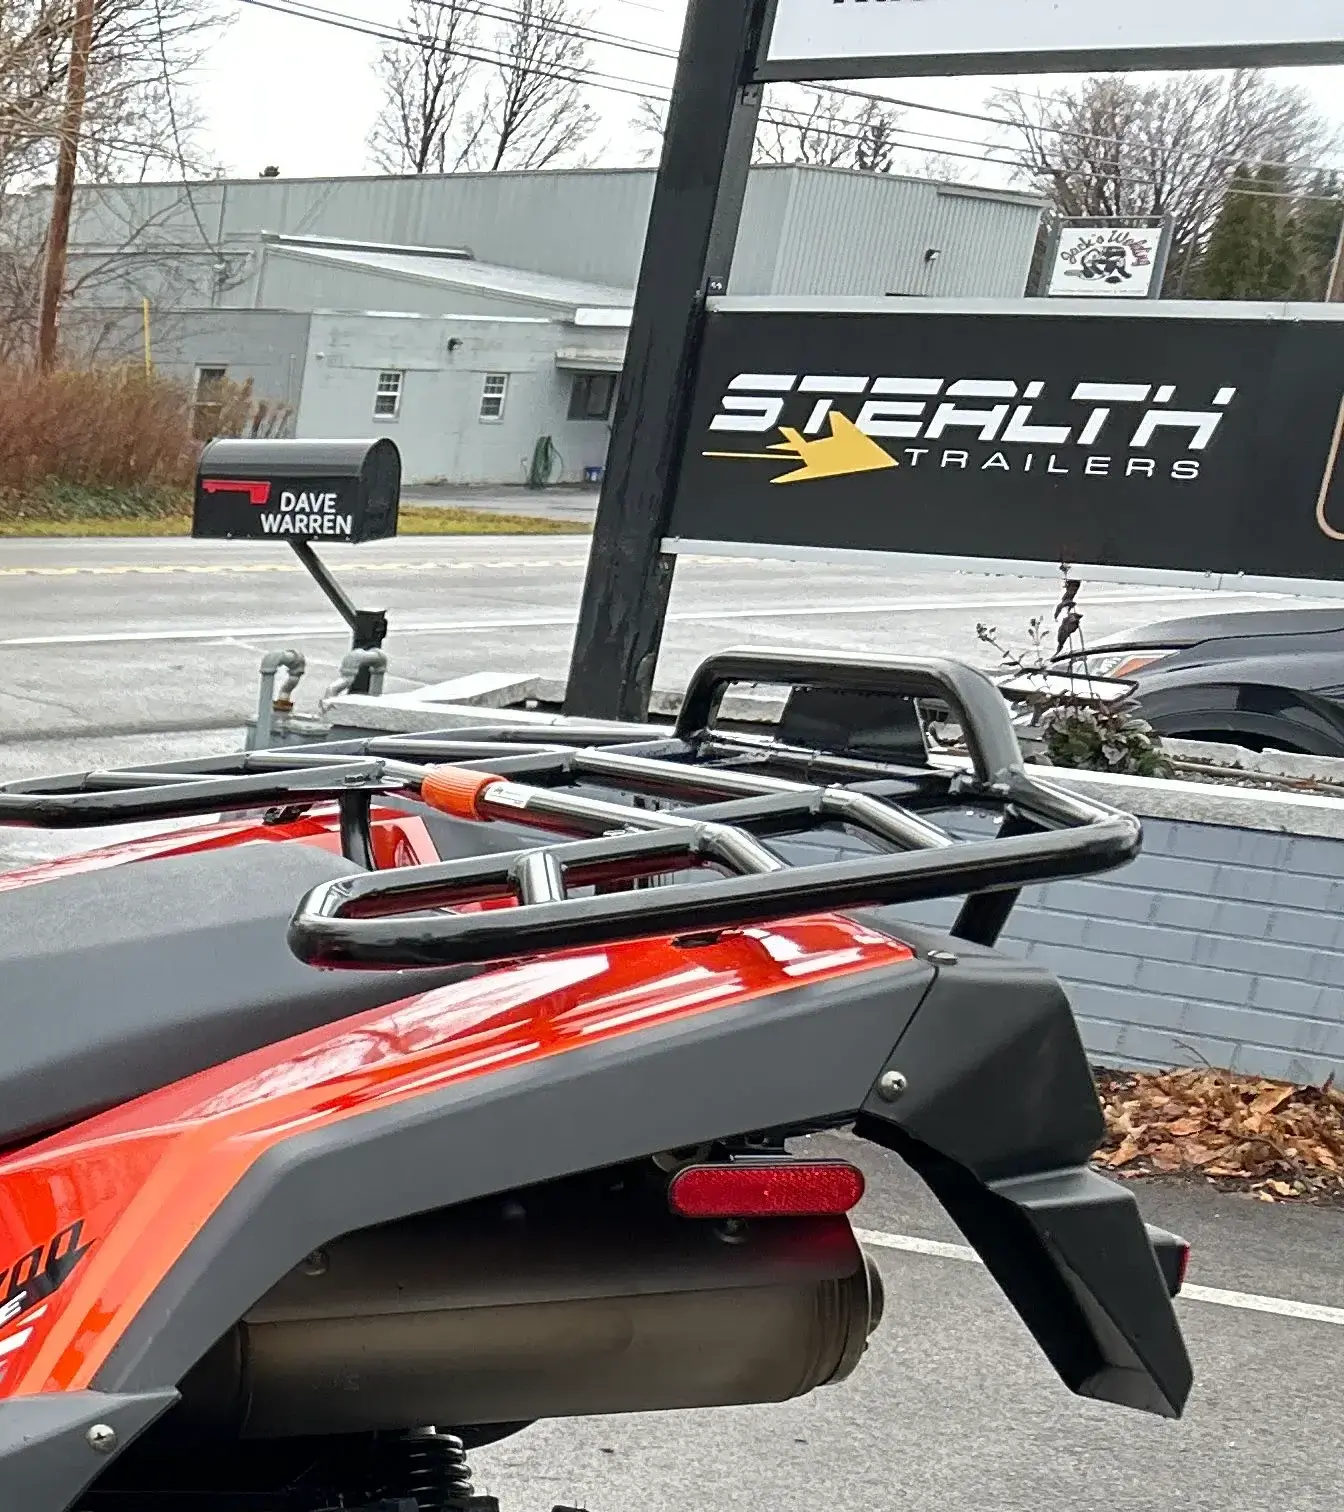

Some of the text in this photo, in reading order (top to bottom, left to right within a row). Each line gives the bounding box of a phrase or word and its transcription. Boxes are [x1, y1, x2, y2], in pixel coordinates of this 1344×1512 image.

[709, 372, 1237, 450] STEALTH
[904, 447, 1200, 480] TRAILERS
[280, 492, 337, 512] DAVE
[260, 513, 352, 535] WARREN
